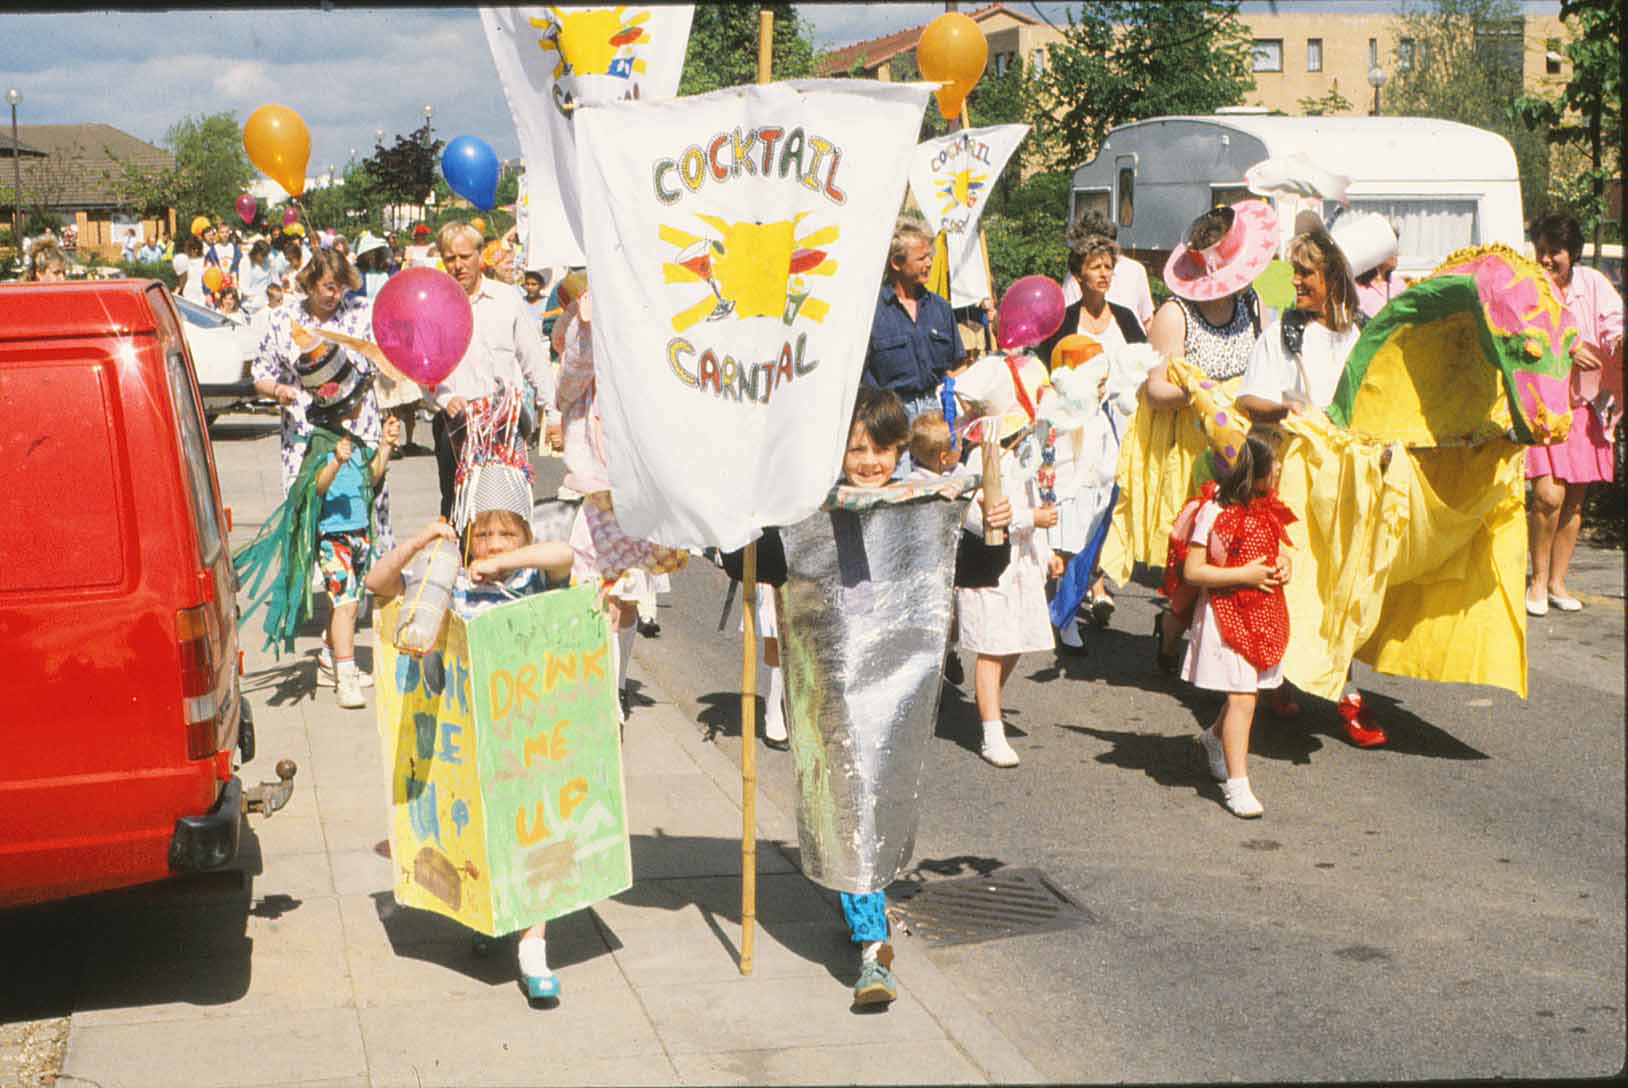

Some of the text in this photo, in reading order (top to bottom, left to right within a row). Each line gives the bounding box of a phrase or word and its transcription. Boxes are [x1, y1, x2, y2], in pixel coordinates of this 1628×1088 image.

[652, 125, 848, 206] COCKTAIL
[489, 643, 609, 721] DRINK
[523, 719, 570, 768] ME
[514, 776, 589, 848] UP
